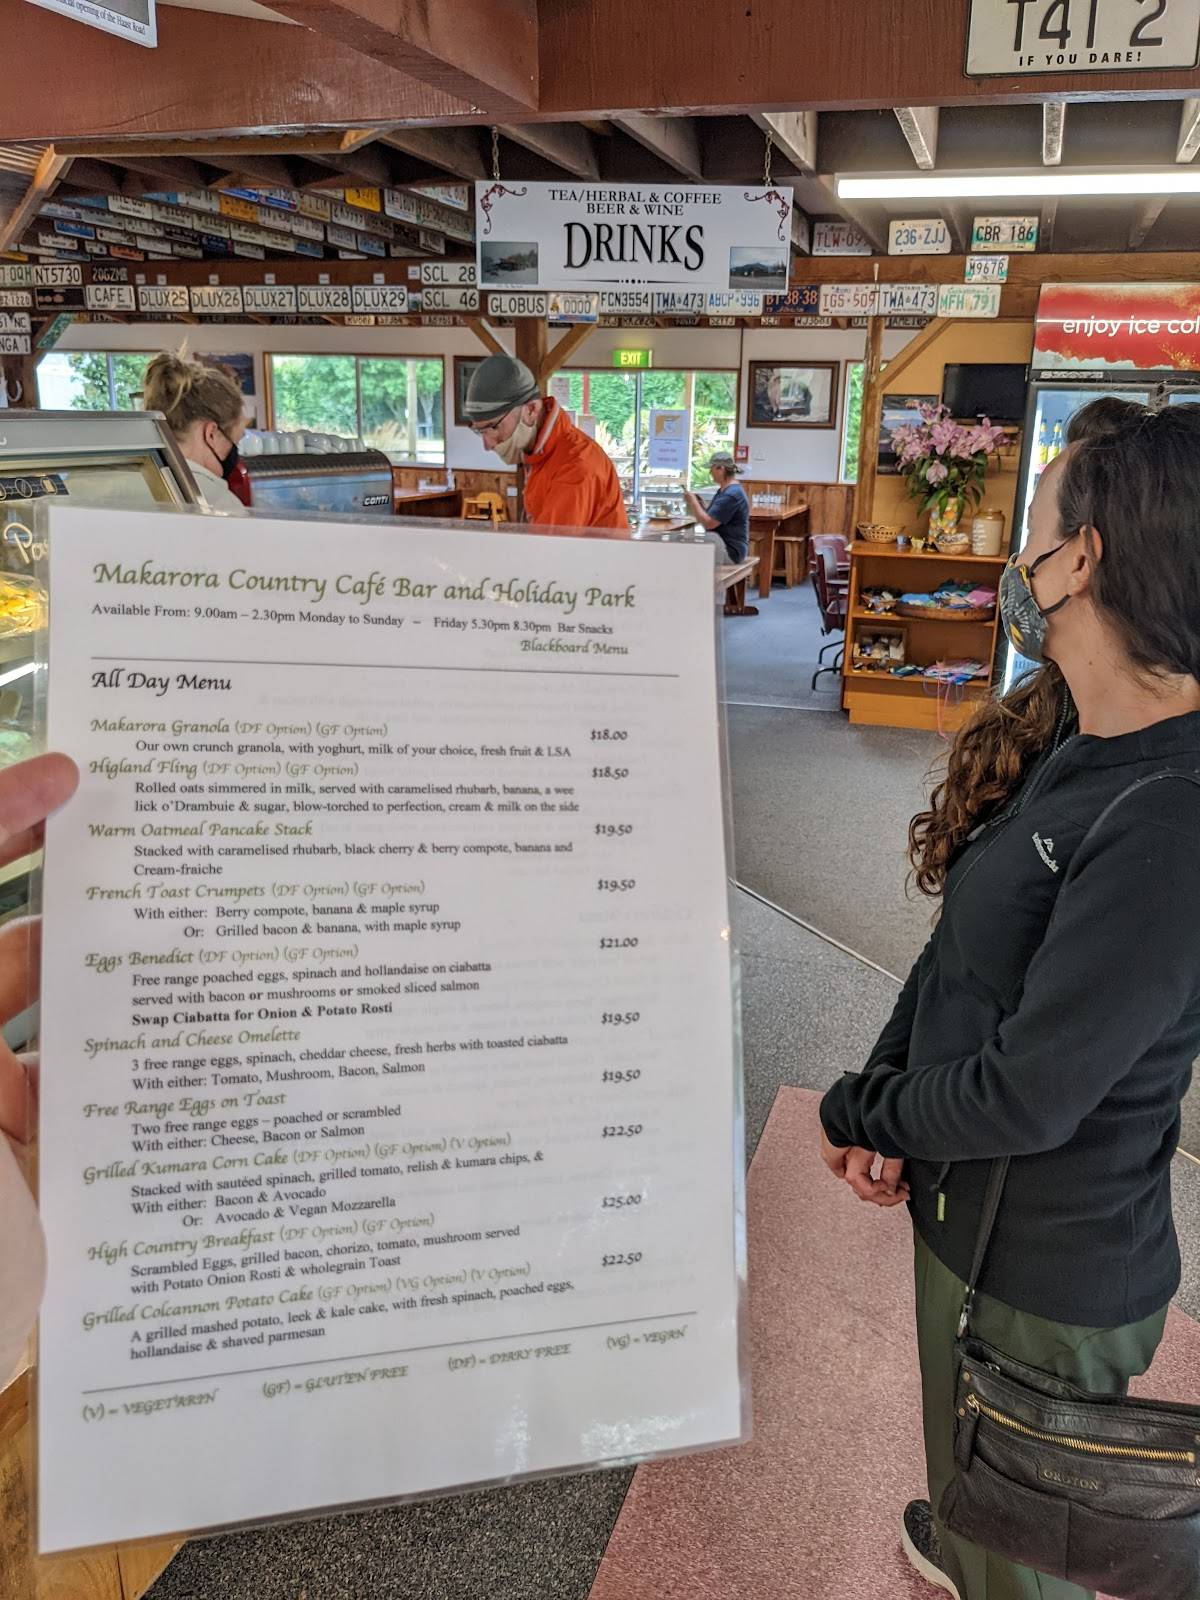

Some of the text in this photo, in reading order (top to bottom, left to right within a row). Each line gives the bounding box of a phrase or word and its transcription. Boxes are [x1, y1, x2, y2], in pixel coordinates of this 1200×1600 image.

[1019, 51, 1142, 66] IF YOU DARE!
[548, 189, 722, 204] TEA/HERBAL & COFFEE
[587, 203, 684, 216] BEER & WINE
[976, 225, 1034, 241] CBR 186
[563, 222, 704, 271] DRINKS
[35, 267, 81, 283] NT5730
[423, 265, 477, 282] SCL 28
[95, 287, 125, 303] CAFE
[140, 291, 187, 307] DLUX25
[192, 292, 240, 308] DLUX26
[246, 291, 295, 307] DLUX27
[300, 291, 349, 307] DLUX28
[354, 291, 406, 307] DLUX29
[424, 291, 477, 307] SCL 46
[600, 292, 649, 307] FCN3554
[490, 297, 545, 313] GLOBUS
[1063, 315, 1121, 338] enjoy
[1128, 315, 1161, 336] ice
[620, 352, 641, 365] EXIT
[93, 561, 635, 615] Makarora Country Café Bar and Holiday Park
[91, 603, 150, 616] Available
[154, 605, 190, 617] From:
[194, 606, 237, 619] 9.00am
[252, 608, 295, 623] 2.30pm
[298, 611, 345, 626] Monday
[348, 614, 360, 624] to
[361, 613, 404, 628] Sunday
[433, 616, 468, 631] Friday
[471, 618, 510, 632] 5.30pm
[513, 620, 551, 634] 8.30pm
[557, 622, 576, 633] Bar
[578, 623, 613, 634] Snacks
[520, 637, 628, 655] Blackboard Menu
[91, 668, 232, 696] All Day Menu
[590, 729, 628, 741] $18.00
[592, 766, 629, 780] $18.50
[135, 781, 176, 793] Rolled
[179, 784, 204, 793] oats
[206, 782, 266, 793] simmered
[270, 782, 282, 793] in
[284, 782, 315, 795] milk,
[319, 783, 356, 794] served
[359, 783, 384, 794] with
[387, 783, 452, 794] caramelised
[455, 784, 500, 795] rhubarb,
[502, 784, 542, 795] banana,
[554, 787, 574, 795] wee
[88, 820, 312, 837] Warm Oatmeal Pancake Stack
[595, 824, 632, 836] $19.50
[133, 863, 223, 876] Cream-fraiche
[598, 879, 636, 892] $19.50
[600, 937, 638, 949] $21.00
[132, 1002, 392, 1027] Swap Ciabatta for Onion & Potato Rosti
[601, 1012, 640, 1026] $19.50
[83, 1026, 300, 1059] Spinach and Cheese Omelette
[132, 1062, 425, 1090] With either: Tomato, Mushroom, Bacon, Salmon
[602, 1069, 641, 1083] $19.50
[82, 1091, 286, 1120] Free Range Eggs on Toast
[602, 1124, 643, 1138] $22.50
[602, 1195, 643, 1208] $25.00
[602, 1252, 642, 1267] $22.50
[130, 1256, 400, 1294] with Potato Onion Rosti & wholegrain Toast
[130, 1327, 325, 1359] hollandaise & shaved parmesan
